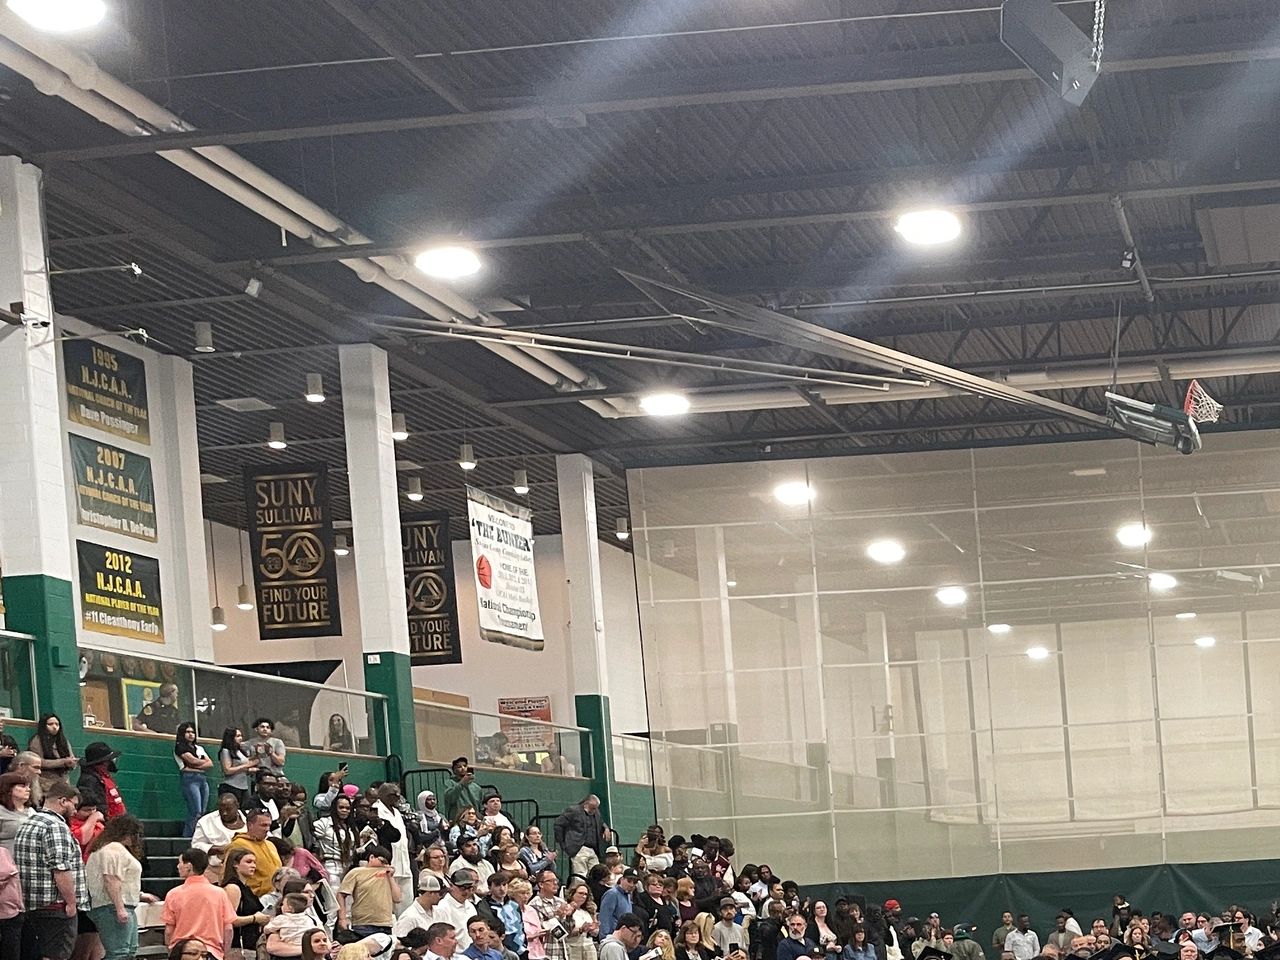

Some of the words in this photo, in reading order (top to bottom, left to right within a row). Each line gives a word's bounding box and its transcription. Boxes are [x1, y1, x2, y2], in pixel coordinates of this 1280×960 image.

[91, 346, 118, 372] 1995
[81, 365, 132, 399] N.J.C.A.A.
[97, 446, 126, 470] 2007
[86, 465, 139, 496] N.J.C.A.A.
[255, 479, 318, 508] SUNY
[255, 507, 323, 525] SULLIVAN
[403, 525, 441, 550] UNY
[105, 551, 133, 574] 2012
[96, 571, 146, 599] N.J.C.A.A.
[262, 588, 292, 603] FIND
[294, 586, 328, 602] YOUR
[85, 593, 111, 607] NATIONAL
[85, 610, 100, 624] #11
[263, 601, 331, 623] FUTURE
[420, 619, 451, 634] YOUR
[411, 633, 453, 652] TURE
